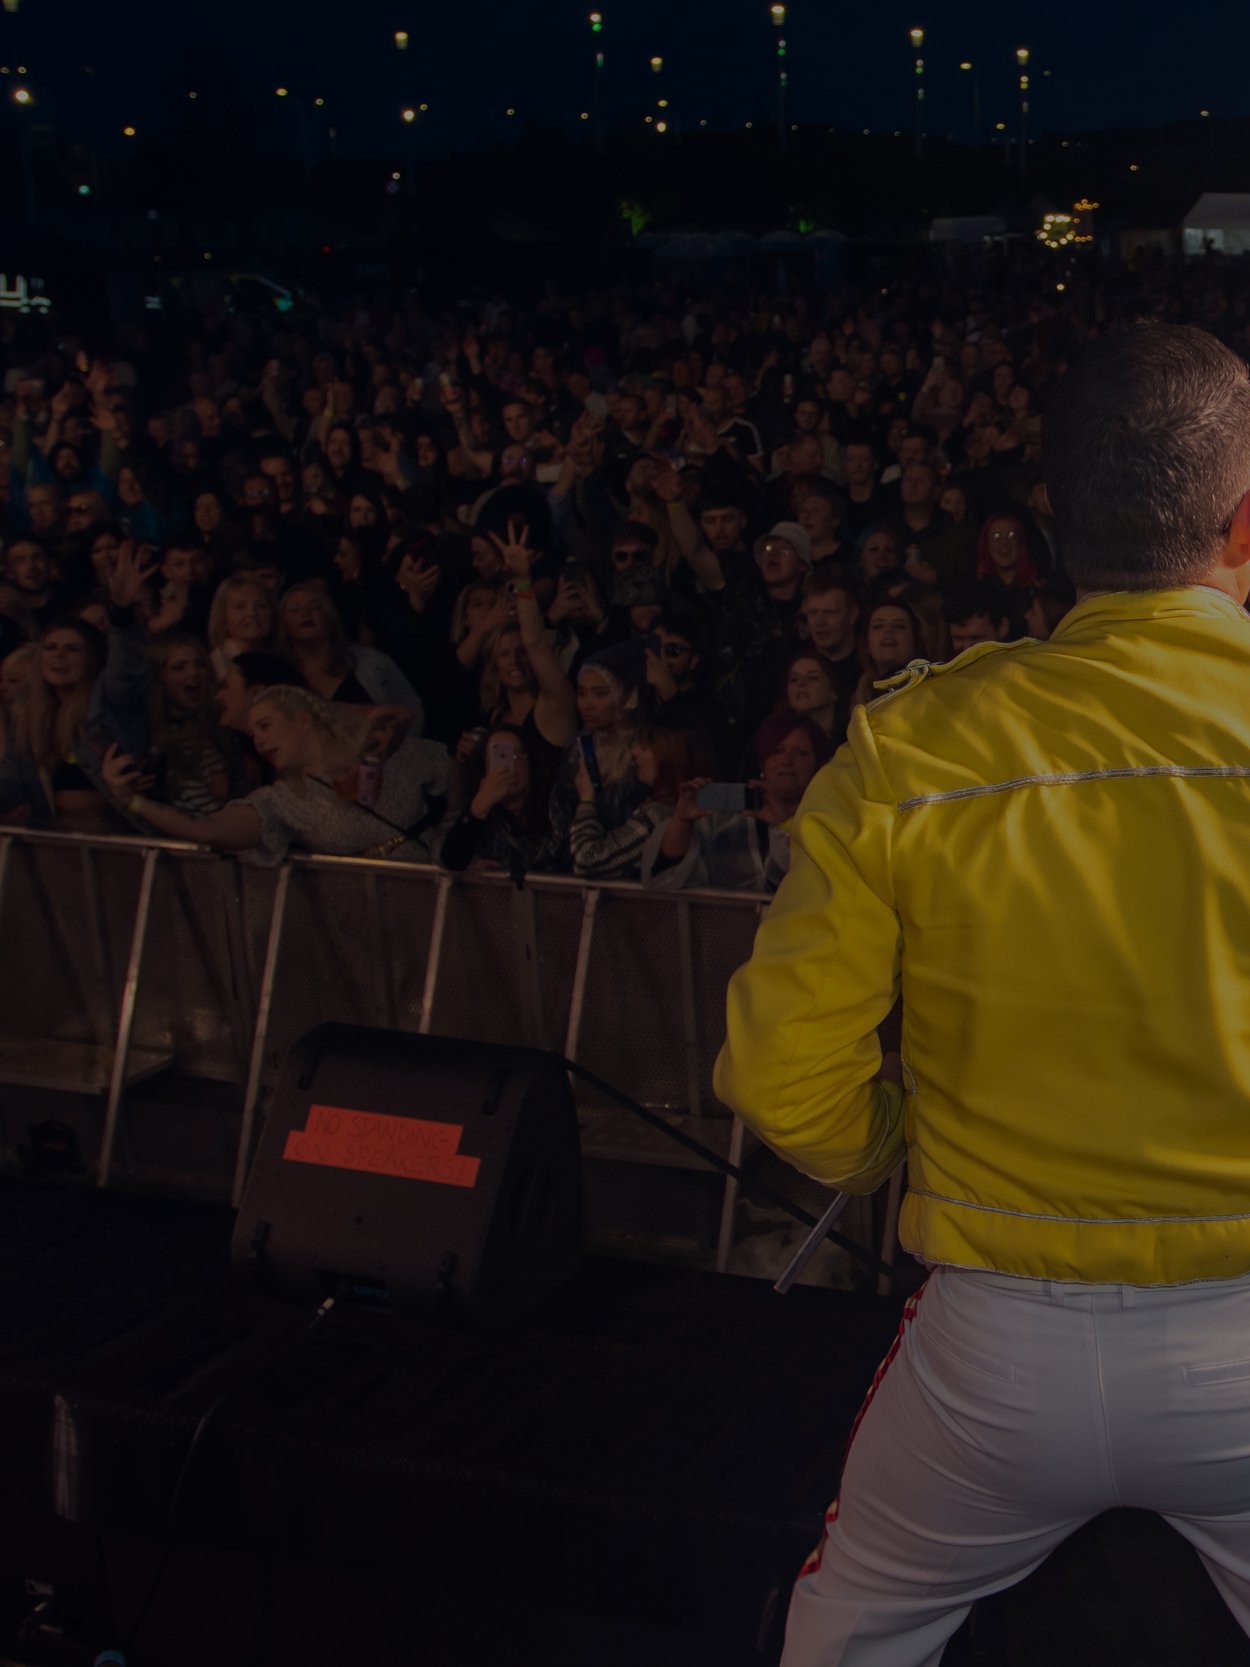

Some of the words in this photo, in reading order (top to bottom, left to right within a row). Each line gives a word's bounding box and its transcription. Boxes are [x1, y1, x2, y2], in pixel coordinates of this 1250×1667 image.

[315, 1112, 341, 1136] NO
[346, 1115, 450, 1150] STANDING
[294, 1136, 328, 1163] ON
